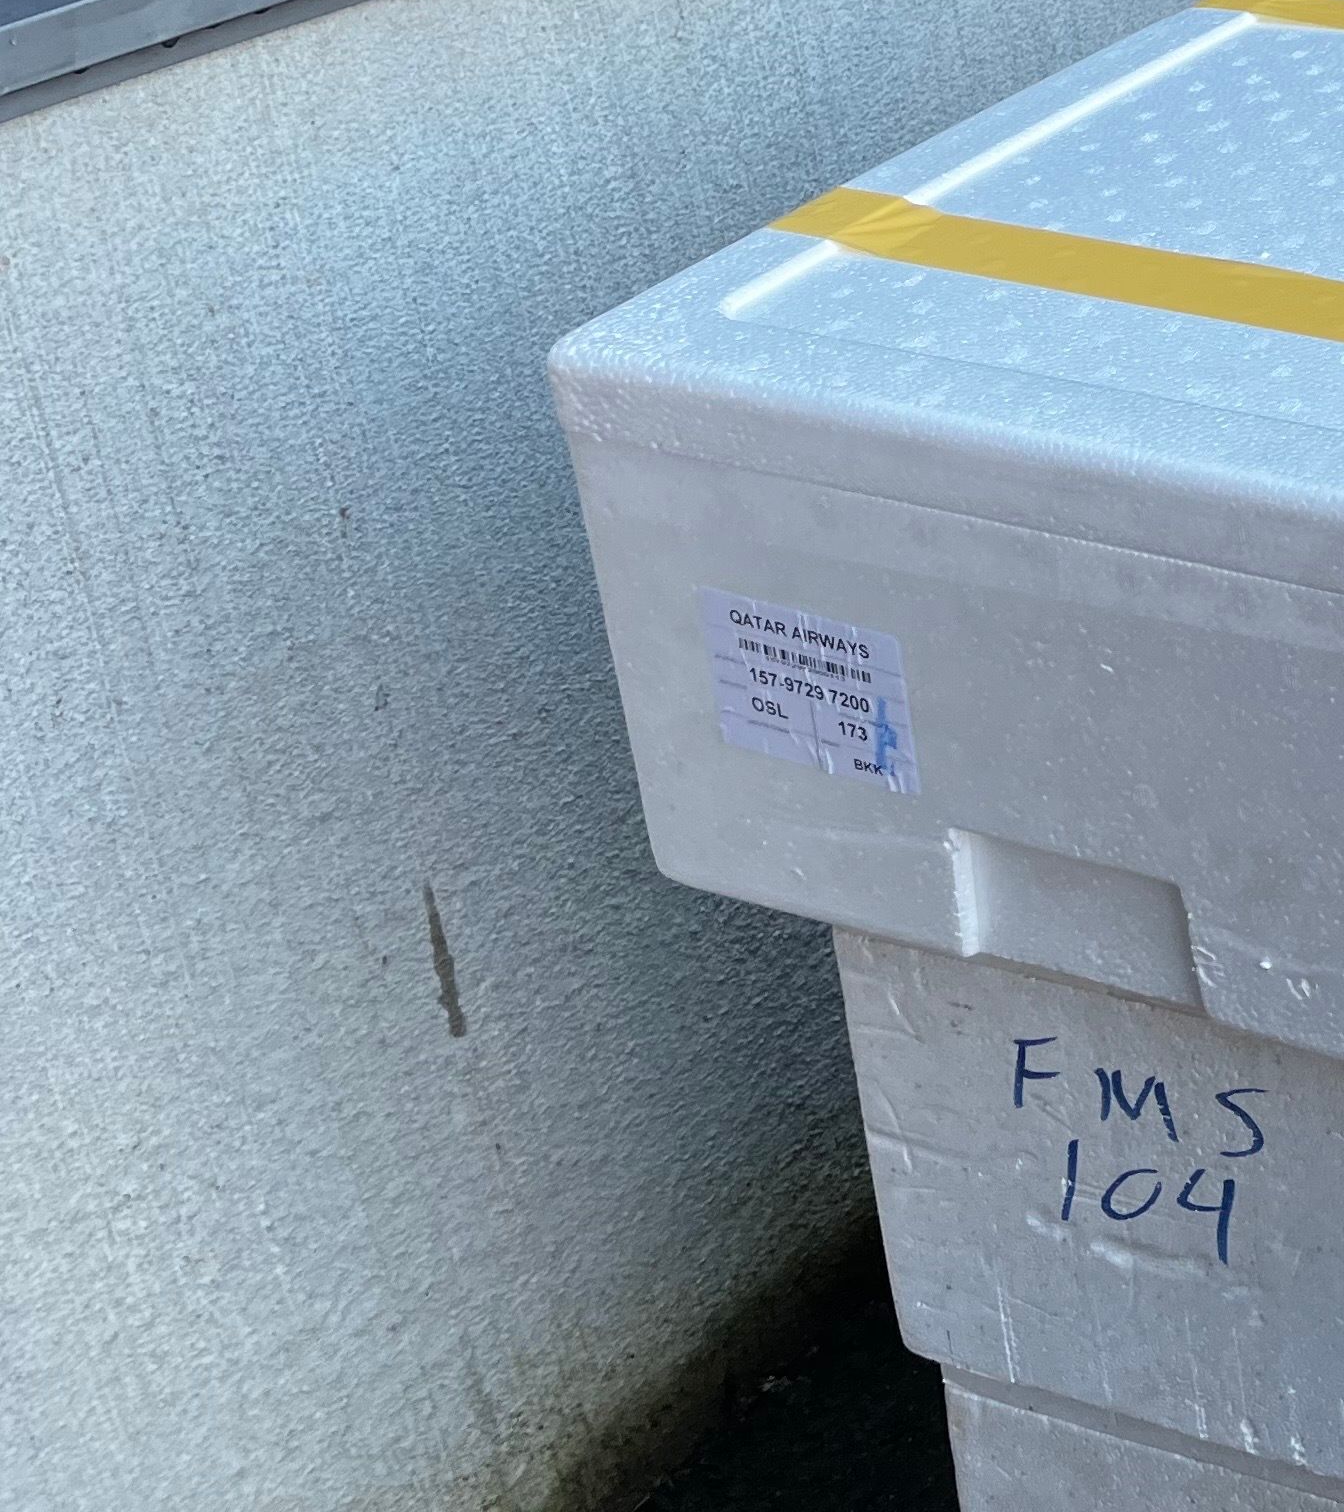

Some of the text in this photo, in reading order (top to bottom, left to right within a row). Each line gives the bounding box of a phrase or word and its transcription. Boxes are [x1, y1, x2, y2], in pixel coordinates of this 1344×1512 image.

[729, 609, 870, 659] QATAR AIRWAYS
[749, 667, 825, 701] 157-9729
[828, 688, 870, 713] 7200
[751, 696, 789, 719] OSL
[837, 720, 868, 742] 173
[853, 757, 884, 777] BKK
[1060, 1138, 1236, 1266] 104
